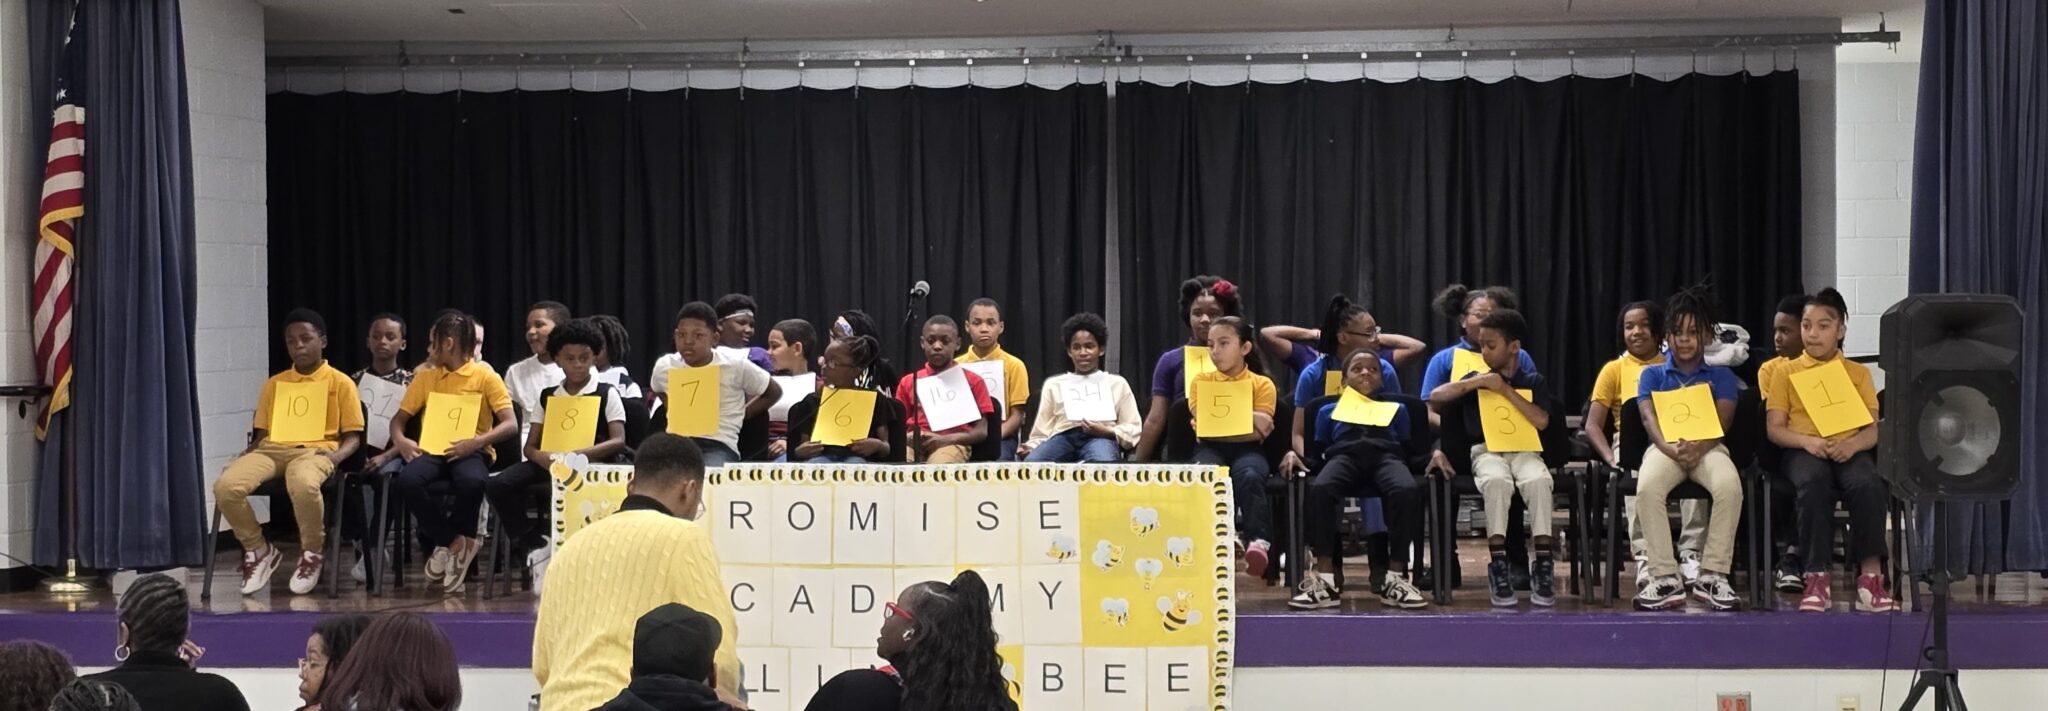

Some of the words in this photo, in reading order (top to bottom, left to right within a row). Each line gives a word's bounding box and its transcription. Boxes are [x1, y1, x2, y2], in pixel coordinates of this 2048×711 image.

[362, 387, 394, 420] 21
[681, 379, 700, 407] 7
[929, 386, 957, 407] 16
[1069, 382, 1101, 402] 24
[1812, 379, 1846, 409] 1
[287, 394, 310, 417] 10
[834, 402, 852, 428] 6
[1210, 394, 1233, 419] 5
[1669, 402, 1702, 424] 2
[447, 407, 463, 431] 9
[560, 407, 580, 431] 8
[1493, 405, 1517, 435] 3
[729, 500, 1062, 531] ROMISE
[730, 580, 1063, 614] CADMY
[1042, 662, 1190, 694] BEE
